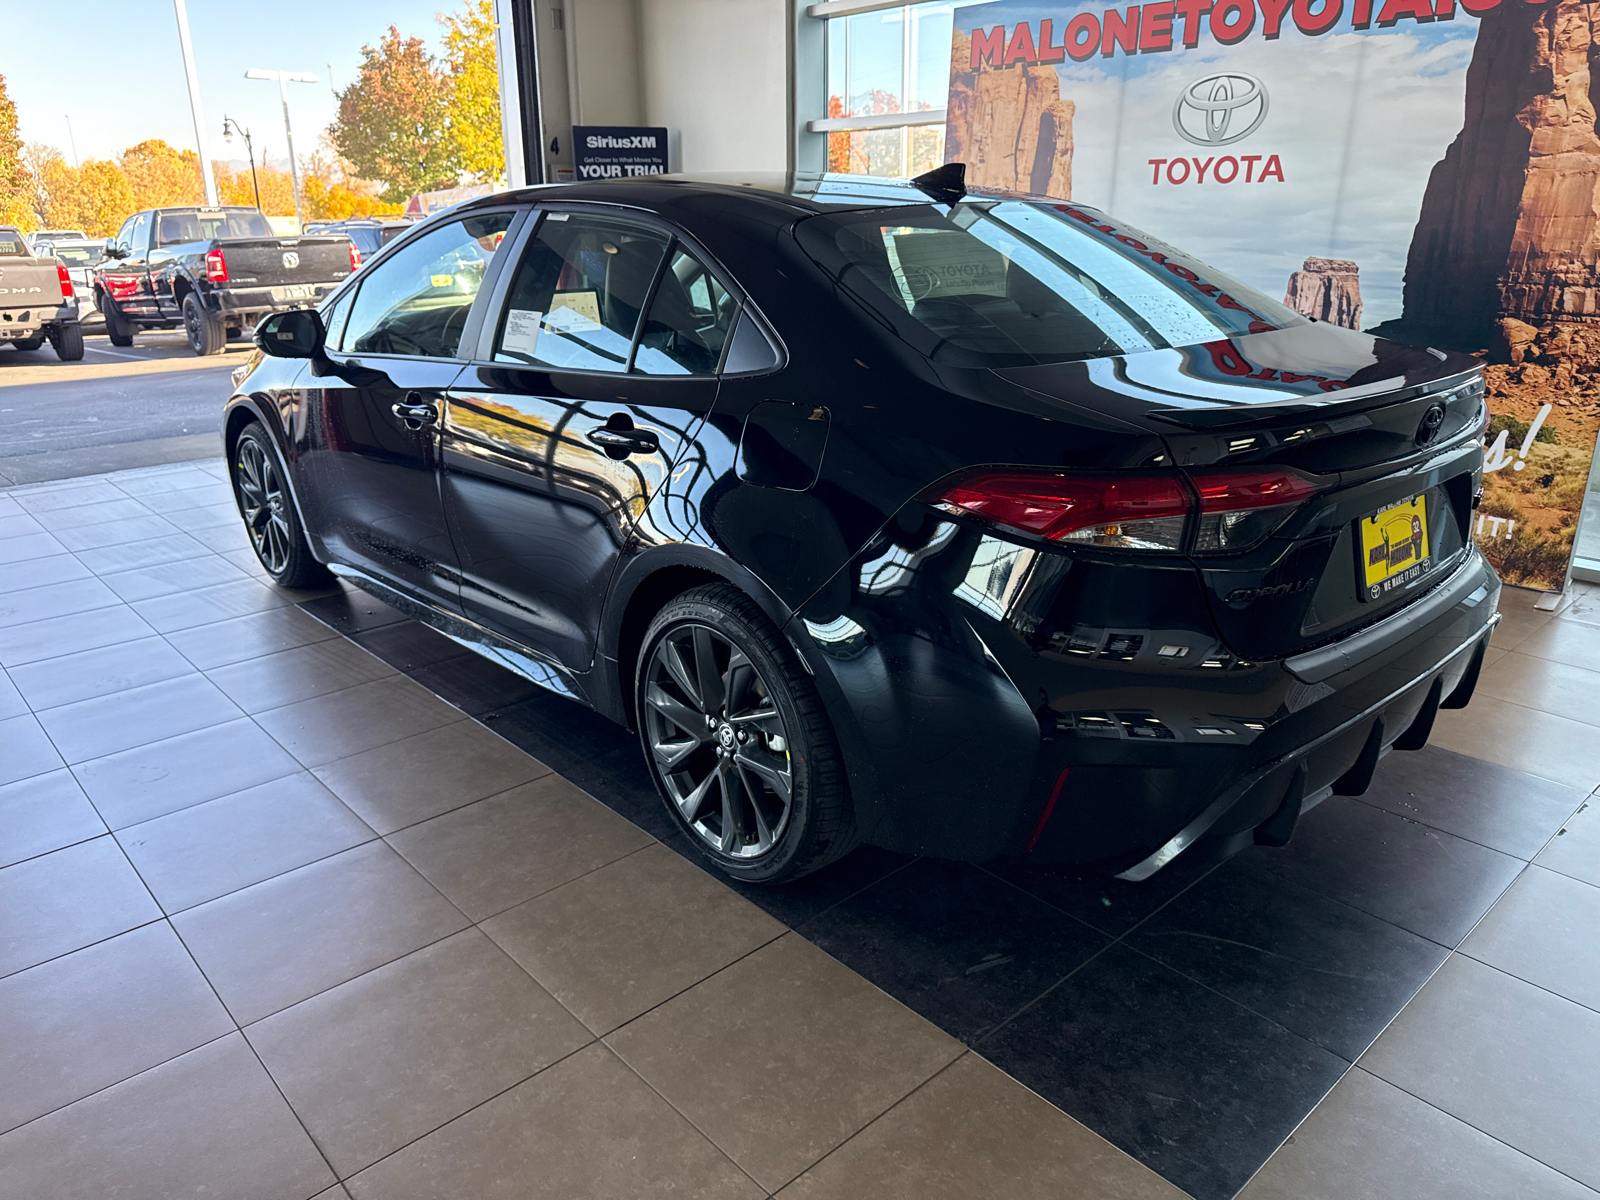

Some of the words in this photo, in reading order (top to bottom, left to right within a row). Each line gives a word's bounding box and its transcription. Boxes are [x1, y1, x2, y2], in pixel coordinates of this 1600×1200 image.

[550, 136, 560, 155] 4
[586, 135, 657, 149] SiriusXM
[579, 165, 622, 178] YOUR
[1148, 154, 1285, 185] TOYOTA
[940, 264, 991, 276] TOYOTA
[1413, 520, 1420, 532] 32
[1476, 514, 1515, 540] IT!
[1383, 581, 1392, 592] WE
[1391, 576, 1405, 588] MAKE
[1404, 573, 1410, 583] IT
[1409, 565, 1420, 578] EASY
